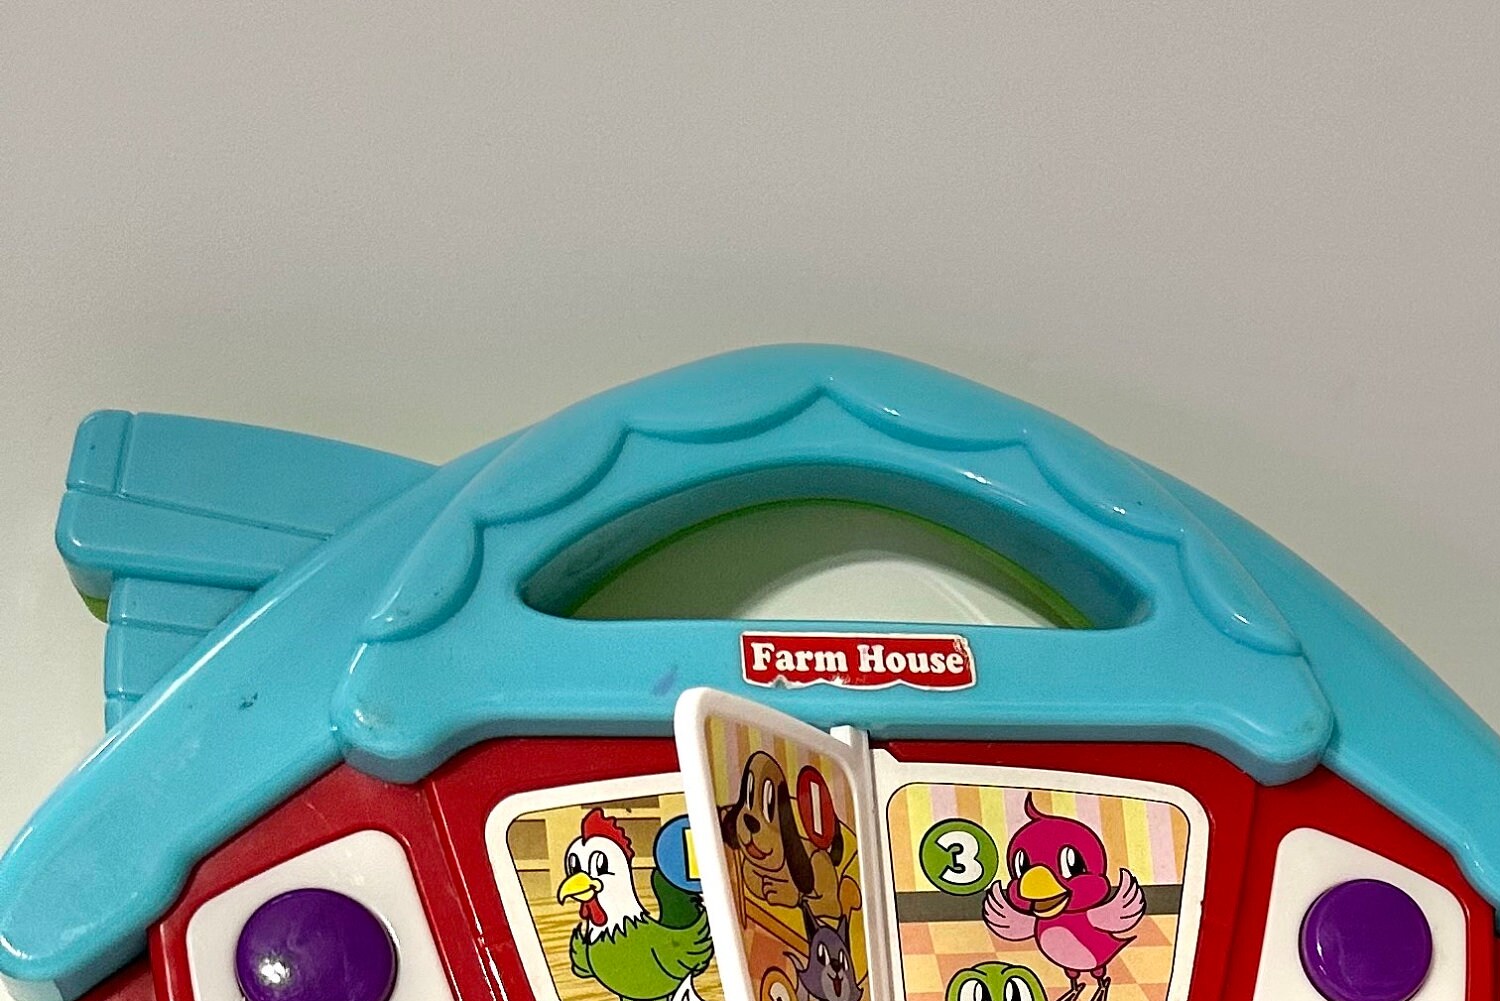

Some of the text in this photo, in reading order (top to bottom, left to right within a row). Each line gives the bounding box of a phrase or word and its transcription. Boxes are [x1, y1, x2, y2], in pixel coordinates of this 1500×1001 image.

[750, 642, 965, 673] Farm House
[943, 829, 982, 885] 3
